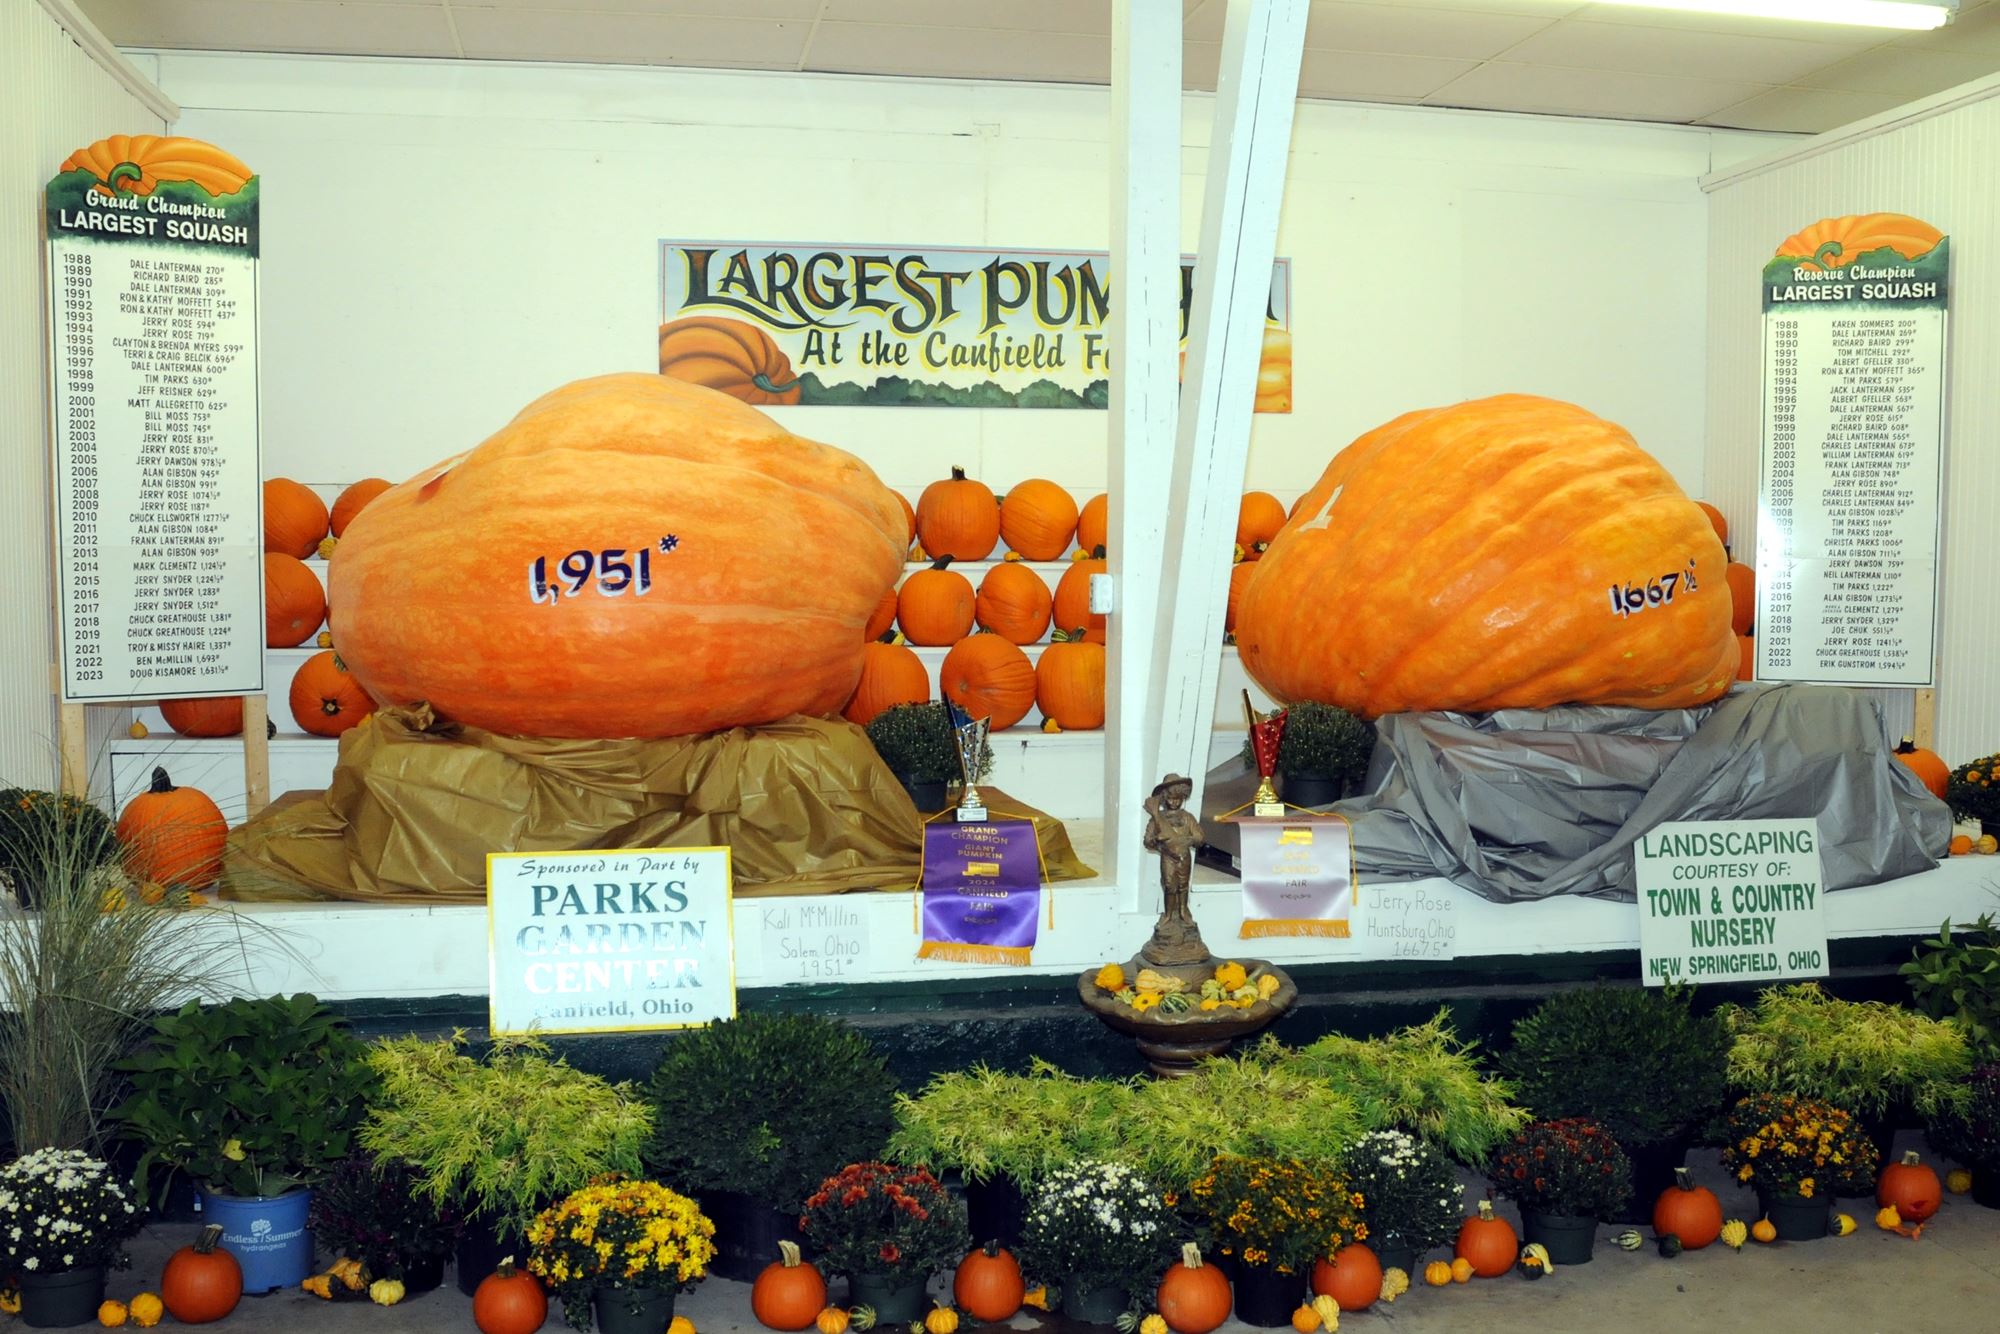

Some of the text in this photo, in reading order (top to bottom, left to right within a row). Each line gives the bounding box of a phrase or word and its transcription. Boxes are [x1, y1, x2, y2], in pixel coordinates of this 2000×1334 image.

[86, 189, 226, 220] Grand Champion
[60, 209, 248, 244] LARGEST SQUASH
[63, 253, 91, 265] 1988
[130, 259, 149, 270] DALE
[154, 261, 201, 273] LANTERMAN
[64, 265, 92, 276] 1989
[134, 271, 170, 282] RICHARD
[174, 273, 199, 284] BAIRD
[1793, 265, 1916, 282] Reserve Champion
[64, 276, 92, 288] 1990
[130, 282, 150, 292] DALE
[154, 284, 202, 296] LANTERMAN
[680, 248, 973, 334] LARGEST
[1772, 283, 1936, 301] LARGEST SQUASH
[65, 311, 93, 322] 1993
[142, 316, 168, 327] JERRY
[172, 318, 192, 328] ROSE
[1776, 321, 1798, 329] 1988
[1832, 320, 1856, 328] KAREN
[1859, 320, 1894, 328] SOMMERS
[1776, 330, 1798, 339] 1989
[1832, 329, 1849, 338] DALE
[1852, 329, 1895, 337] LANTERMAN
[800, 329, 844, 365] At
[862, 331, 910, 366] the
[925, 331, 1065, 372] Canfield
[1775, 339, 1798, 348] 1990
[1832, 339, 1864, 347] RICHARD
[1868, 338, 1891, 346] BAIRD
[67, 369, 93, 380] 1998
[145, 374, 159, 383] TIM
[163, 374, 188, 385] PARKS
[1774, 377, 1797, 385] 1994
[1843, 376, 1855, 384] TIM
[1859, 376, 1882, 385] PARKS
[68, 382, 94, 392] 1999
[137, 385, 155, 395] JEFF
[159, 386, 193, 397] REISNER
[69, 407, 94, 418] 2001
[145, 411, 162, 420] BILL
[166, 412, 189, 421] MOSS
[1773, 414, 1795, 422] 1998
[1839, 414, 1862, 422] JERRY
[1865, 414, 1884, 422] ROSE
[1774, 423, 1796, 432] 1999
[1831, 423, 1862, 431] RICHARD
[1865, 423, 1888, 431] BAIRD
[1773, 451, 1796, 459] 2002
[1823, 451, 1851, 459] WILLIAM
[1854, 451, 1895, 459] LANTERMAN
[71, 466, 98, 476] 2006
[142, 468, 163, 477] ALAN
[166, 468, 197, 478] GIBSON
[73, 548, 98, 558] 2013
[141, 548, 163, 557] ALAN
[167, 547, 196, 557] GIBSON
[528, 533, 679, 606] 1,951#
[73, 589, 99, 600] 2016
[134, 588, 160, 597] JERRY
[163, 587, 194, 597] SNYDER
[1771, 615, 1792, 624] 2018
[1821, 616, 1844, 624] JERRY
[1846, 616, 1874, 624] SNYDER
[75, 657, 102, 667] 2022
[136, 656, 152, 665] BEN
[156, 655, 192, 664] McMILLIN
[951, 832, 1008, 845] CHAMPION
[961, 826, 998, 835] GRAND
[965, 844, 995, 852] GIANT
[1644, 830, 1813, 858] LANDSCAPING
[958, 849, 1003, 859] PUMPKIN
[517, 856, 700, 879] Sponsored in Part by
[1673, 862, 1791, 880] COURTESY OF:
[531, 881, 689, 917] PARKS
[957, 887, 1008, 898] CANFIELD
[1647, 883, 1816, 917] TOWN & COUNTRY
[1369, 888, 1451, 917] Jerry Rose
[516, 920, 706, 956] GARDEN
[1367, 916, 1456, 944] Huntsburg Ohio
[1691, 917, 1776, 948] NURSERY
[824, 935, 860, 956] Ohio
[1650, 950, 1821, 977] NEW SPRINGFIELD, OHIO
[524, 958, 703, 993] CENTER
[643, 999, 693, 1015] Ohio
[222, 1228, 304, 1244] Endless Summer
[240, 1242, 287, 1252] hydrangeas
